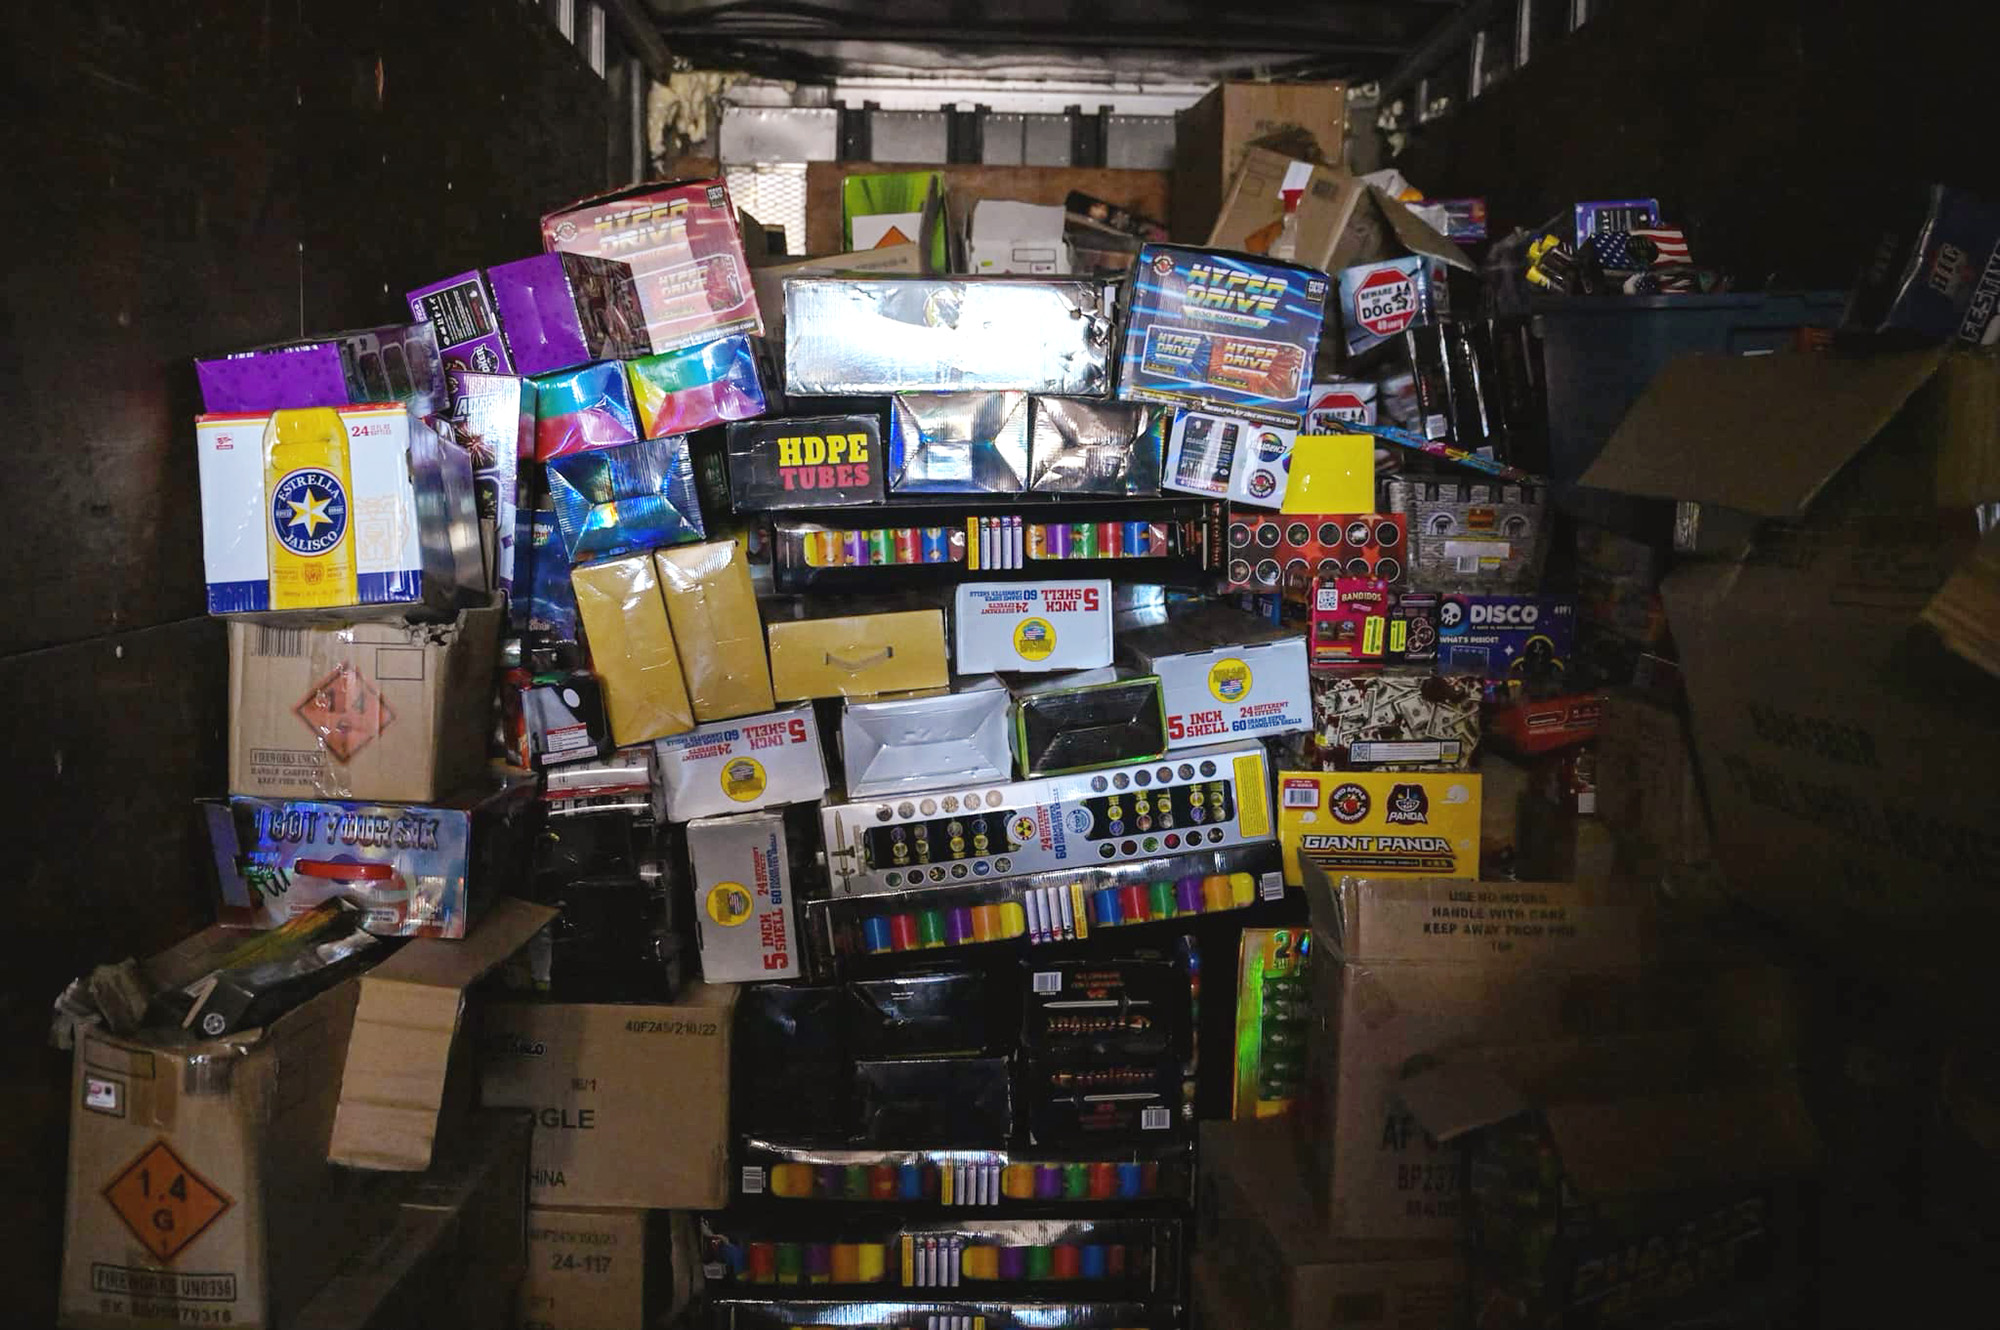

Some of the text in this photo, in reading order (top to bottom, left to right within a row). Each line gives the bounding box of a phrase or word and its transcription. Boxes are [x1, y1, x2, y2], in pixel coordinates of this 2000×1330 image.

[1187, 263, 1289, 297] HYPER
[1187, 284, 1280, 318] DRIVE
[1360, 288, 1392, 300] BEWARE
[1362, 303, 1393, 319] DOG
[1157, 332, 1201, 347] HYPER
[1157, 342, 1197, 357] DRIVE
[1225, 342, 1278, 360] HYPER
[1223, 354, 1273, 369] DRIVE
[351, 425, 369, 437] 24
[777, 433, 869, 467] HDPE
[778, 465, 870, 491] TUBES
[277, 473, 341, 502] ESTRELLA
[284, 530, 338, 552] JALISCO
[1023, 589, 1038, 601] 60
[1041, 588, 1082, 601] SHELL
[1046, 588, 1099, 613] 5 INCH
[1341, 592, 1382, 602] BANDIDOS
[1015, 602, 1029, 613] 24
[1469, 604, 1539, 624] DISCO
[1240, 706, 1254, 718] 24
[742, 721, 787, 740] SHELL
[1167, 710, 1223, 740] 5 INCH
[1186, 721, 1229, 738] SHELL
[1232, 719, 1247, 732] 60
[723, 728, 740, 742] 60
[750, 718, 807, 750] 5 INCH
[717, 743, 733, 756] 24
[1387, 811, 1427, 823] PANDA
[269, 810, 320, 844] GOT
[324, 813, 393, 849] YOUR
[1040, 837, 1053, 851] 24
[1303, 835, 1451, 851] GIANT PANDA
[1054, 844, 1067, 860] 60
[1432, 907, 1485, 919] HANDLE
[1490, 908, 1524, 920] WITH
[772, 908, 787, 952] SHELL
[1423, 922, 1458, 935] KEEP
[764, 952, 788, 970] 5
[528, 1108, 595, 1130] GLE
[530, 1167, 565, 1187] HINA
[152, 1208, 175, 1231] G
